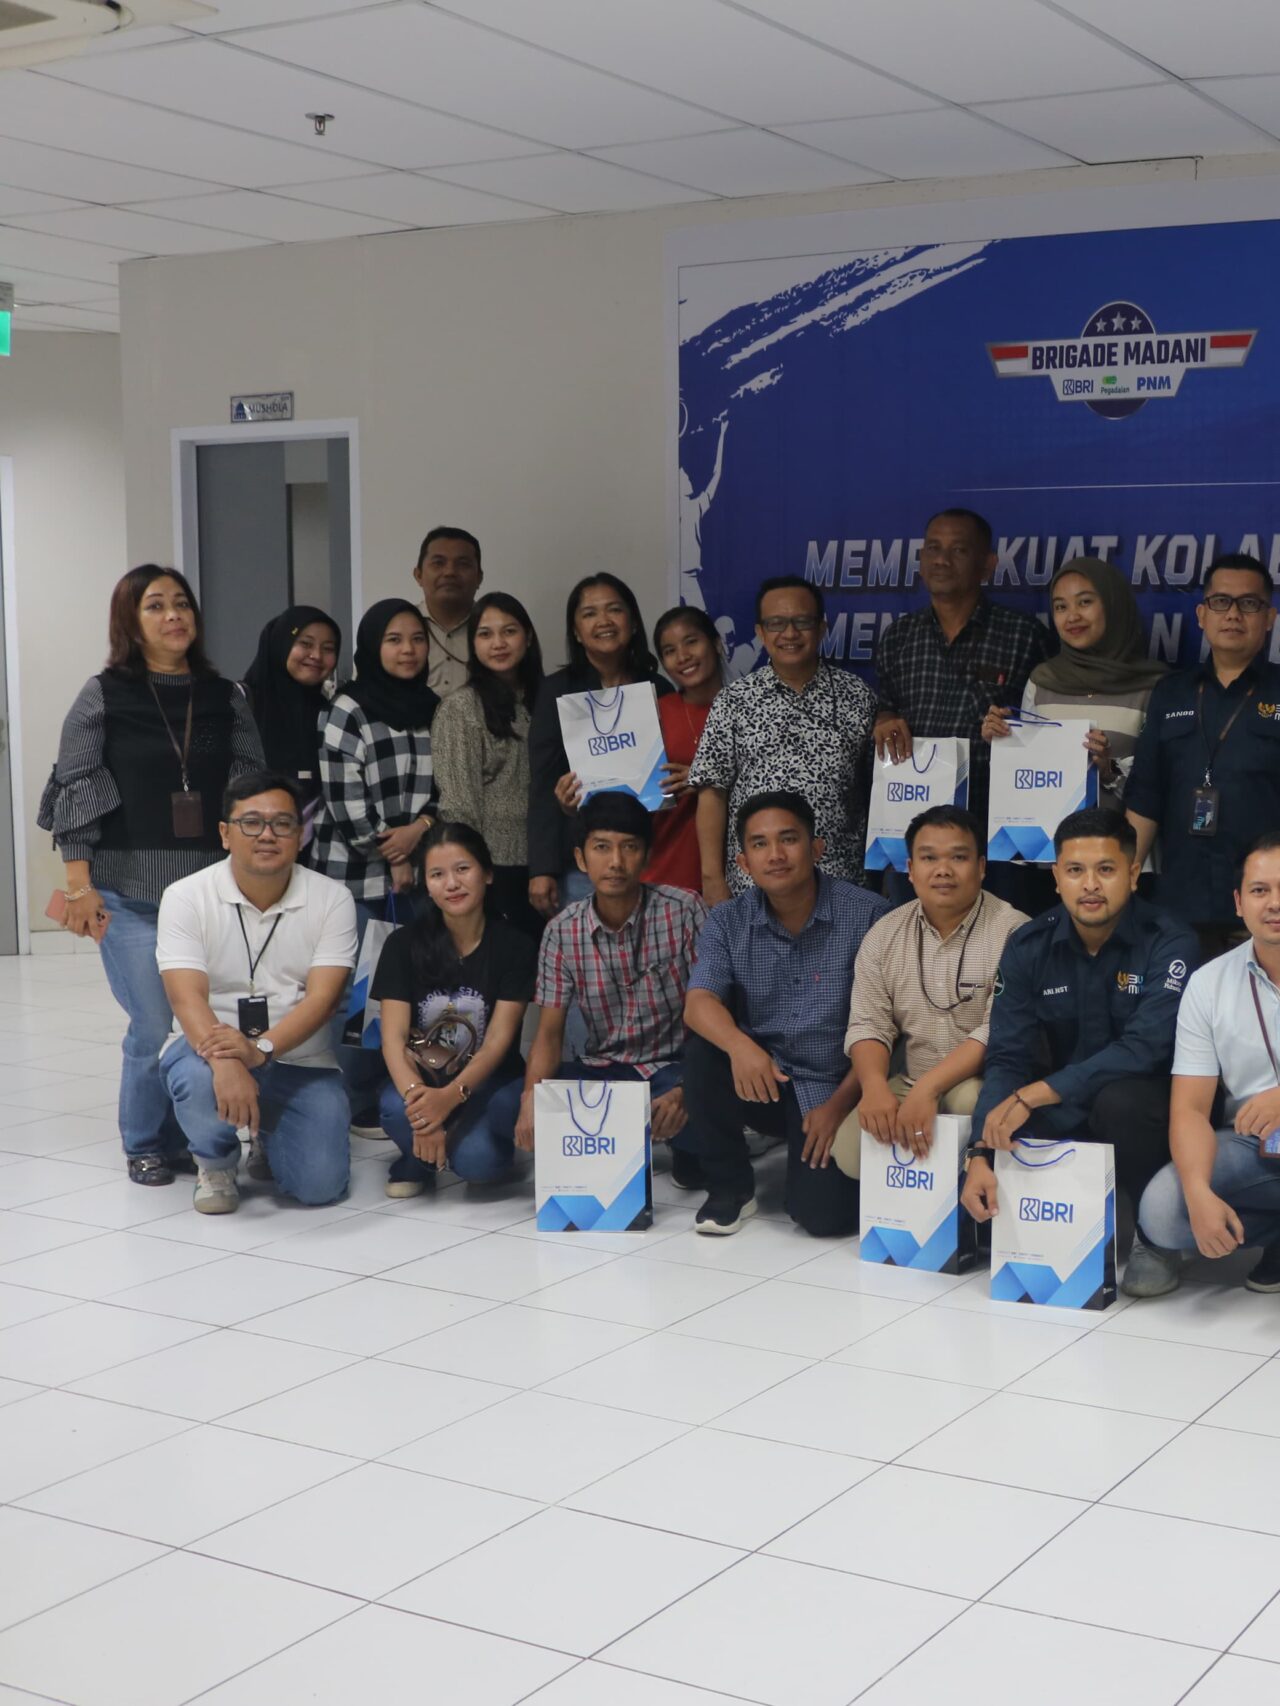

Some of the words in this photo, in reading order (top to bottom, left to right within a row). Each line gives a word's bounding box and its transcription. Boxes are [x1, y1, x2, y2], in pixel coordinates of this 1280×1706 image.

[1031, 342, 1118, 371] BRIGADE
[1123, 338, 1207, 367] MADANI
[1074, 380, 1094, 394] BRI
[1137, 375, 1171, 391] PNM
[606, 731, 637, 752] BRI
[1034, 770, 1063, 788] BRI
[904, 784, 930, 802] BRI
[584, 1137, 616, 1155] BRI
[905, 1169, 934, 1191] BRI
[1041, 1201, 1074, 1224] BRI
